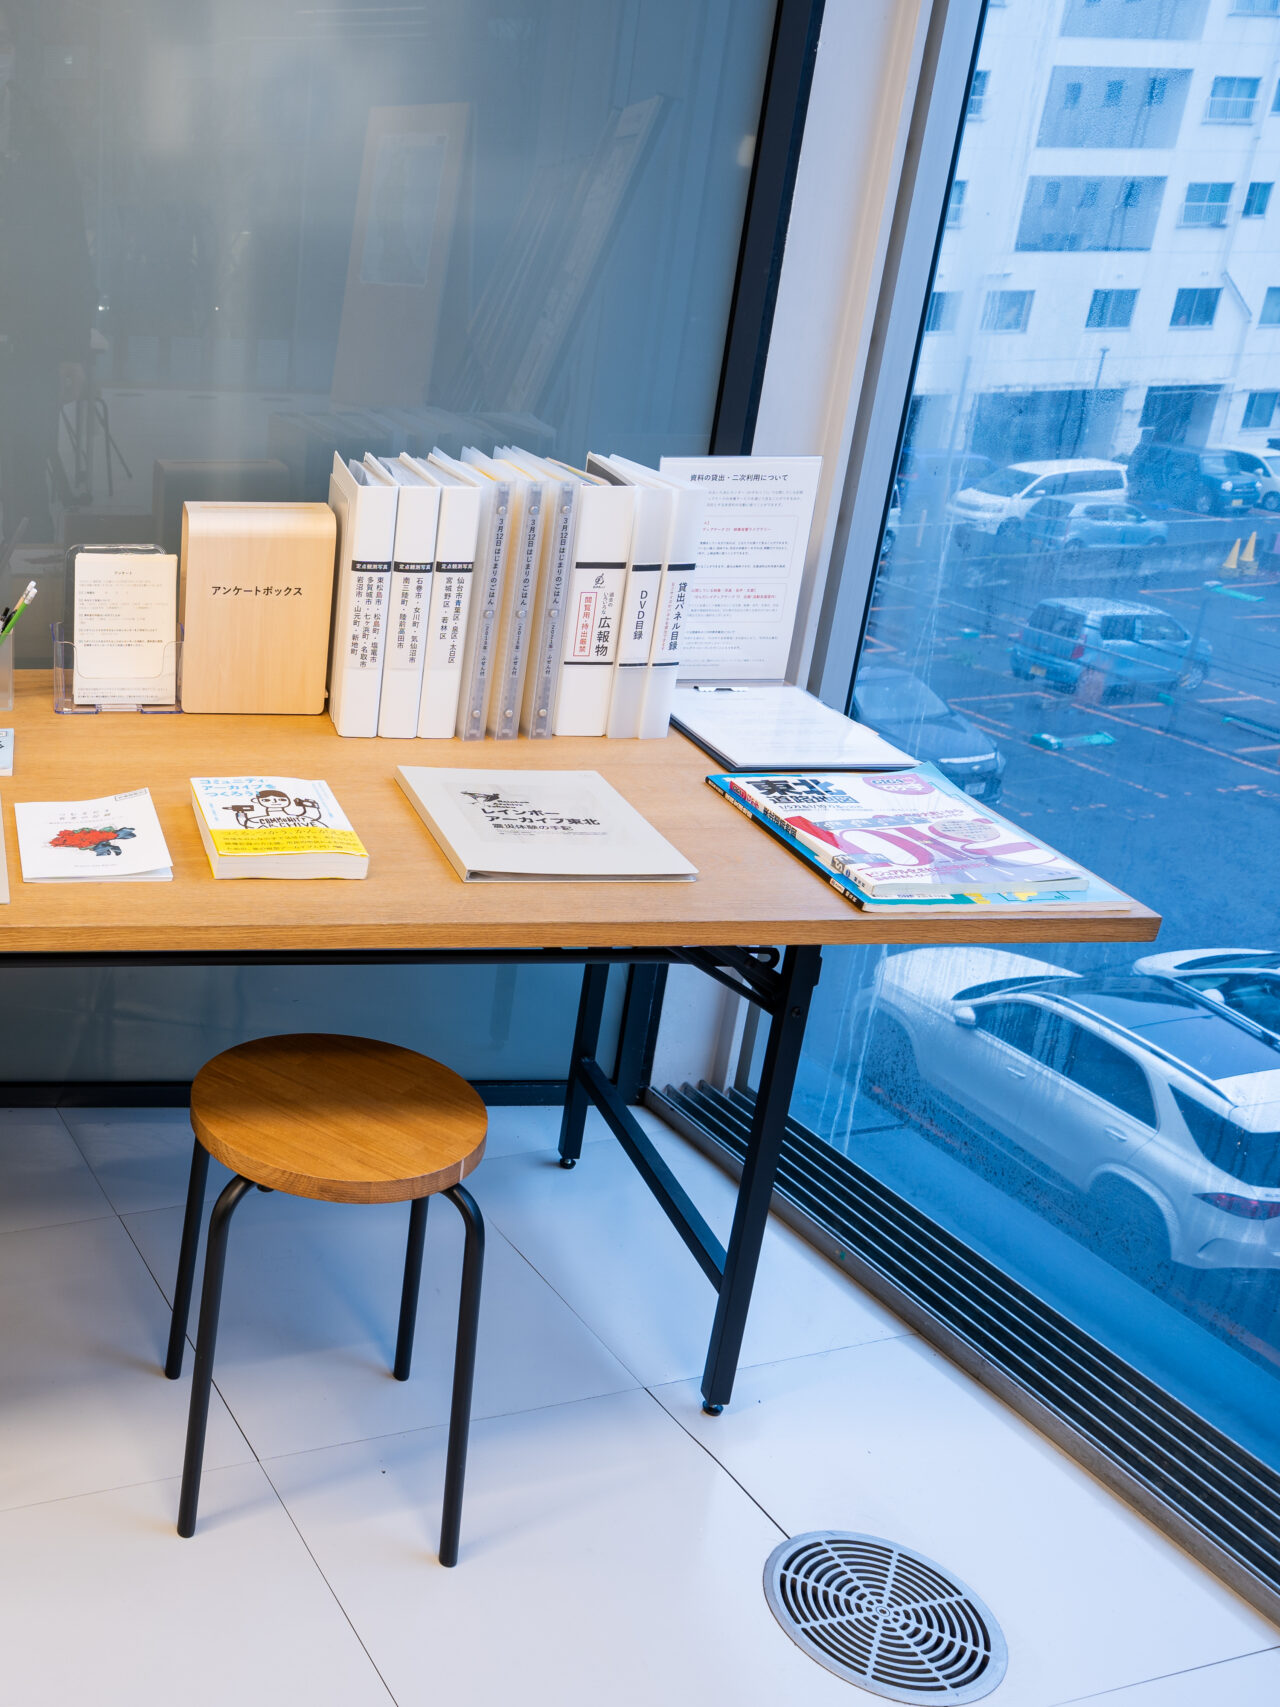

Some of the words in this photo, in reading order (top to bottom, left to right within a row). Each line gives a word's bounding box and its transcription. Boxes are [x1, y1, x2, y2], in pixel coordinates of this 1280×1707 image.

[689, 473, 789, 483] 資料の貸出・二次利用について
[211, 585, 303, 596] アンケートボックス
[632, 590, 648, 641] DVD目録
[668, 582, 688, 651] 貸出パネル目録
[594, 616, 612, 657] 広報物
[745, 779, 847, 796] 東北
[481, 808, 560, 816] レインボー
[485, 815, 601, 826] アーカイブ東北
